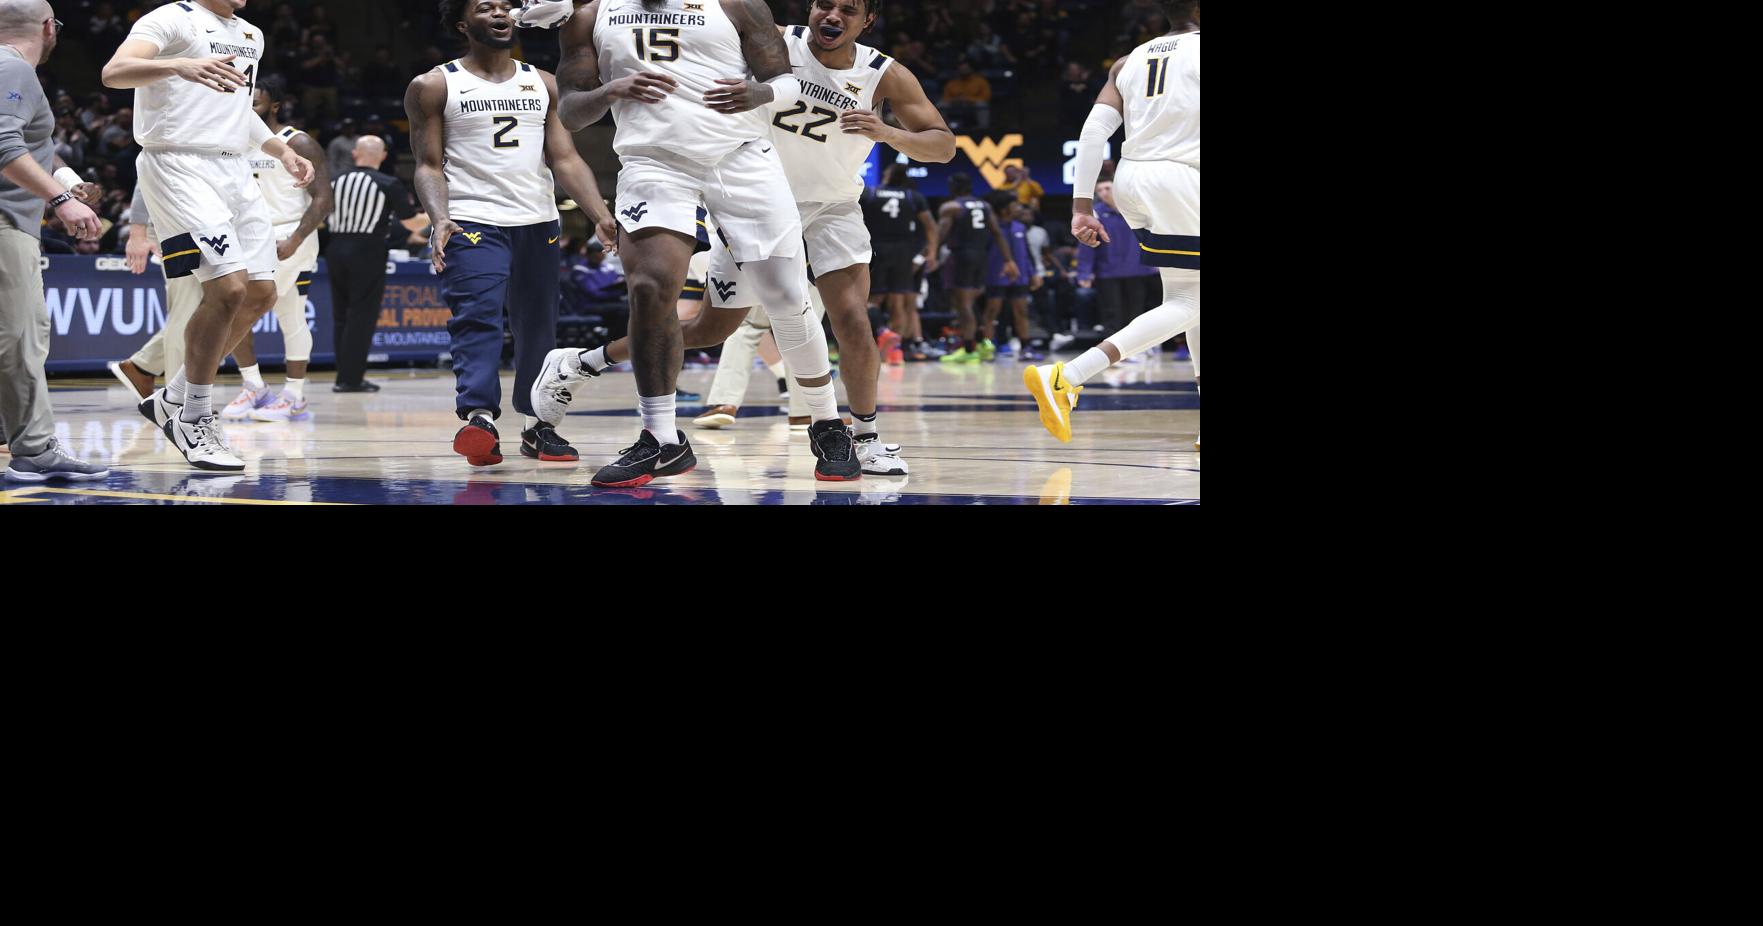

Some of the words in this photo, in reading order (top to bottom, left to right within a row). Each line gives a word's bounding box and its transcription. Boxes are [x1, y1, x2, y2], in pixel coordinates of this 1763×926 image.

[608, 13, 706, 27] MOUNTAINEERS
[632, 28, 679, 62] 15
[1147, 39, 1180, 54] WAGUE
[1146, 56, 1170, 97] 11
[797, 79, 858, 110] NTAINEERS
[460, 99, 542, 113] MOUNTAINEERS
[772, 100, 838, 143] 22
[493, 116, 519, 148] 2
[881, 198, 901, 218] 4
[971, 209, 985, 229] 2
[96, 257, 133, 271] GEIC
[382, 285, 444, 305] FFICIAL
